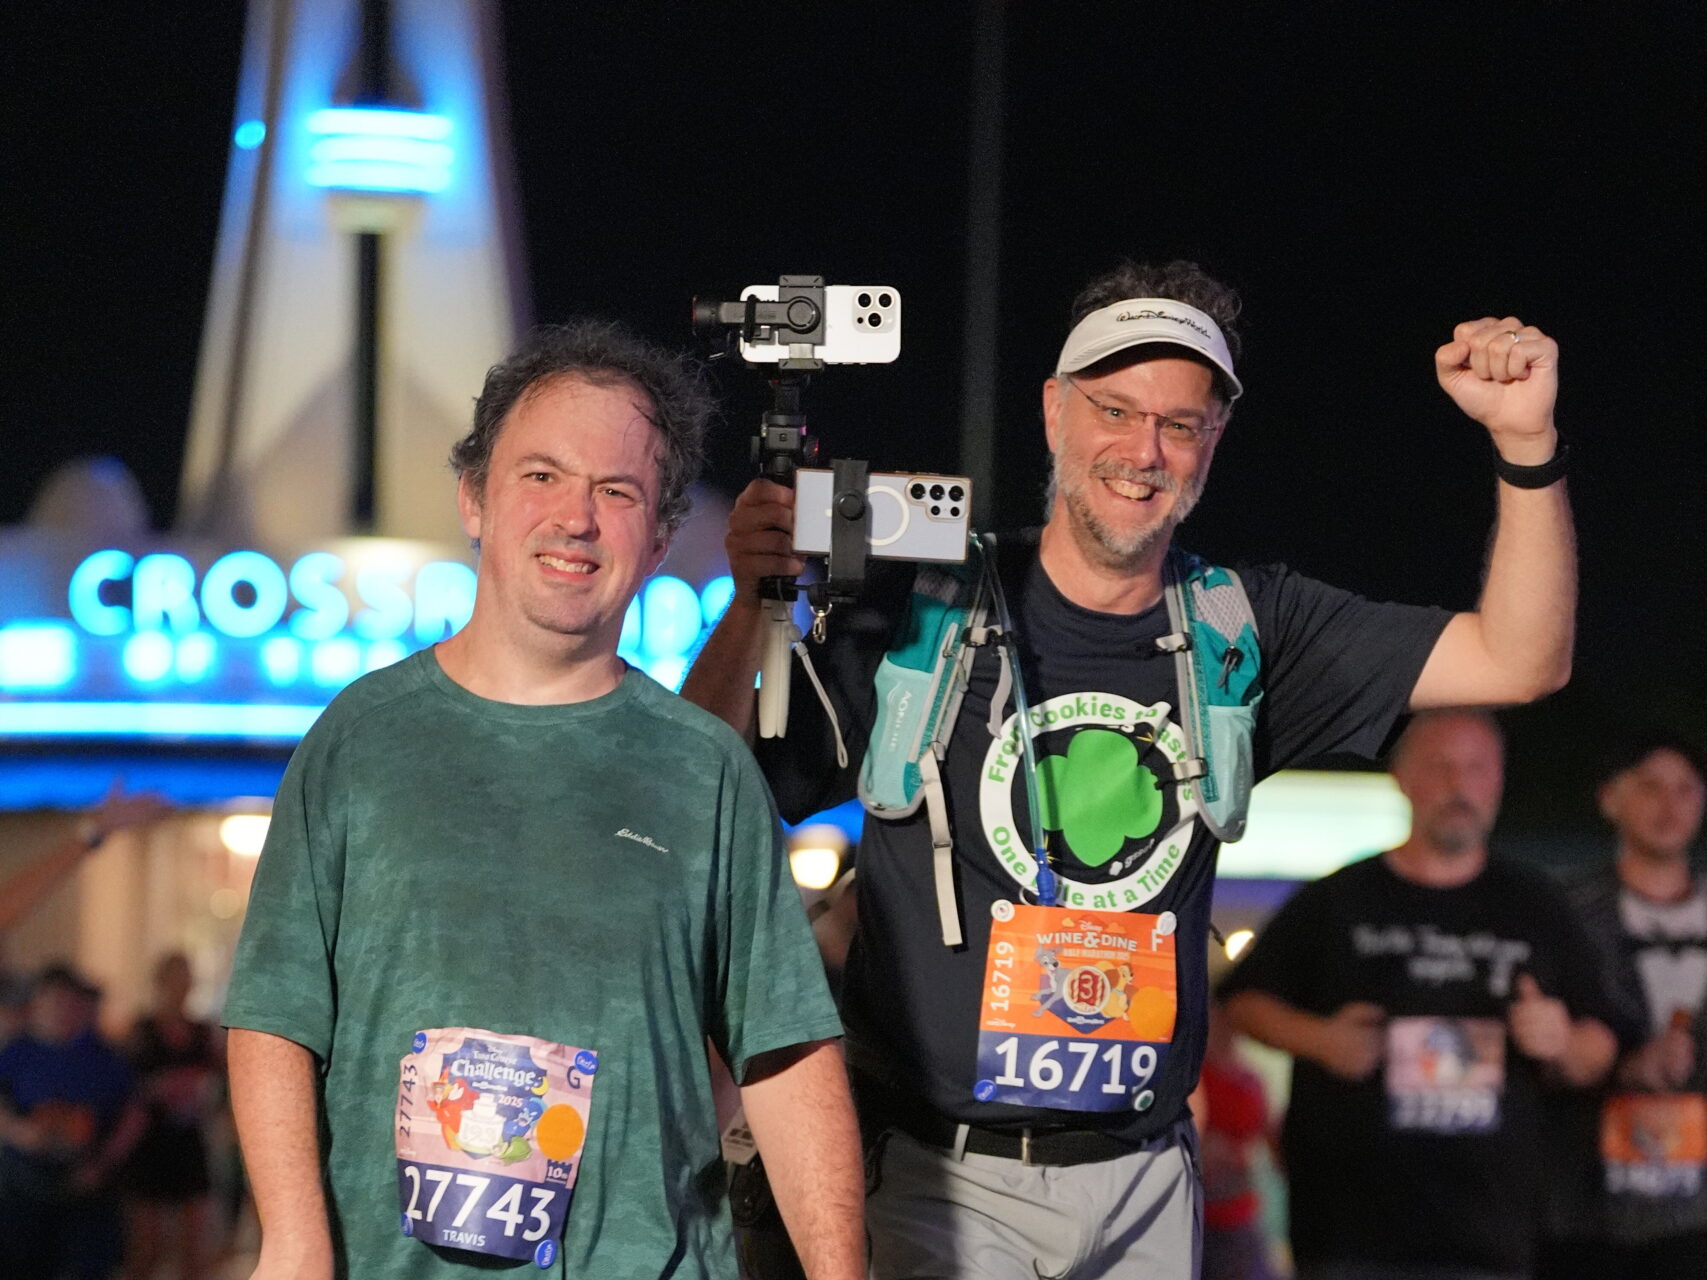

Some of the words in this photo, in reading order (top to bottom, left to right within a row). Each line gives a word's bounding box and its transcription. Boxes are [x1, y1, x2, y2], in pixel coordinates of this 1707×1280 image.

[1141, 310, 1184, 325] Disney
[1029, 697, 1126, 728] Cookies
[1135, 708, 1158, 721] to
[993, 826, 1028, 877] One
[1030, 878, 1085, 906] ile
[1094, 891, 1118, 909] at
[1123, 888, 1139, 904] a
[1136, 843, 1181, 892] Time
[1151, 929, 1163, 952] F
[990, 941, 1015, 1012] 16719
[450, 1059, 536, 1087] Challenge
[566, 1065, 580, 1090] G
[994, 1036, 1158, 1095] 16719
[398, 1063, 418, 1138] 27743
[498, 1094, 524, 1108] 2025
[403, 1165, 556, 1243] 27743
[443, 1229, 486, 1247] TRAVIS
